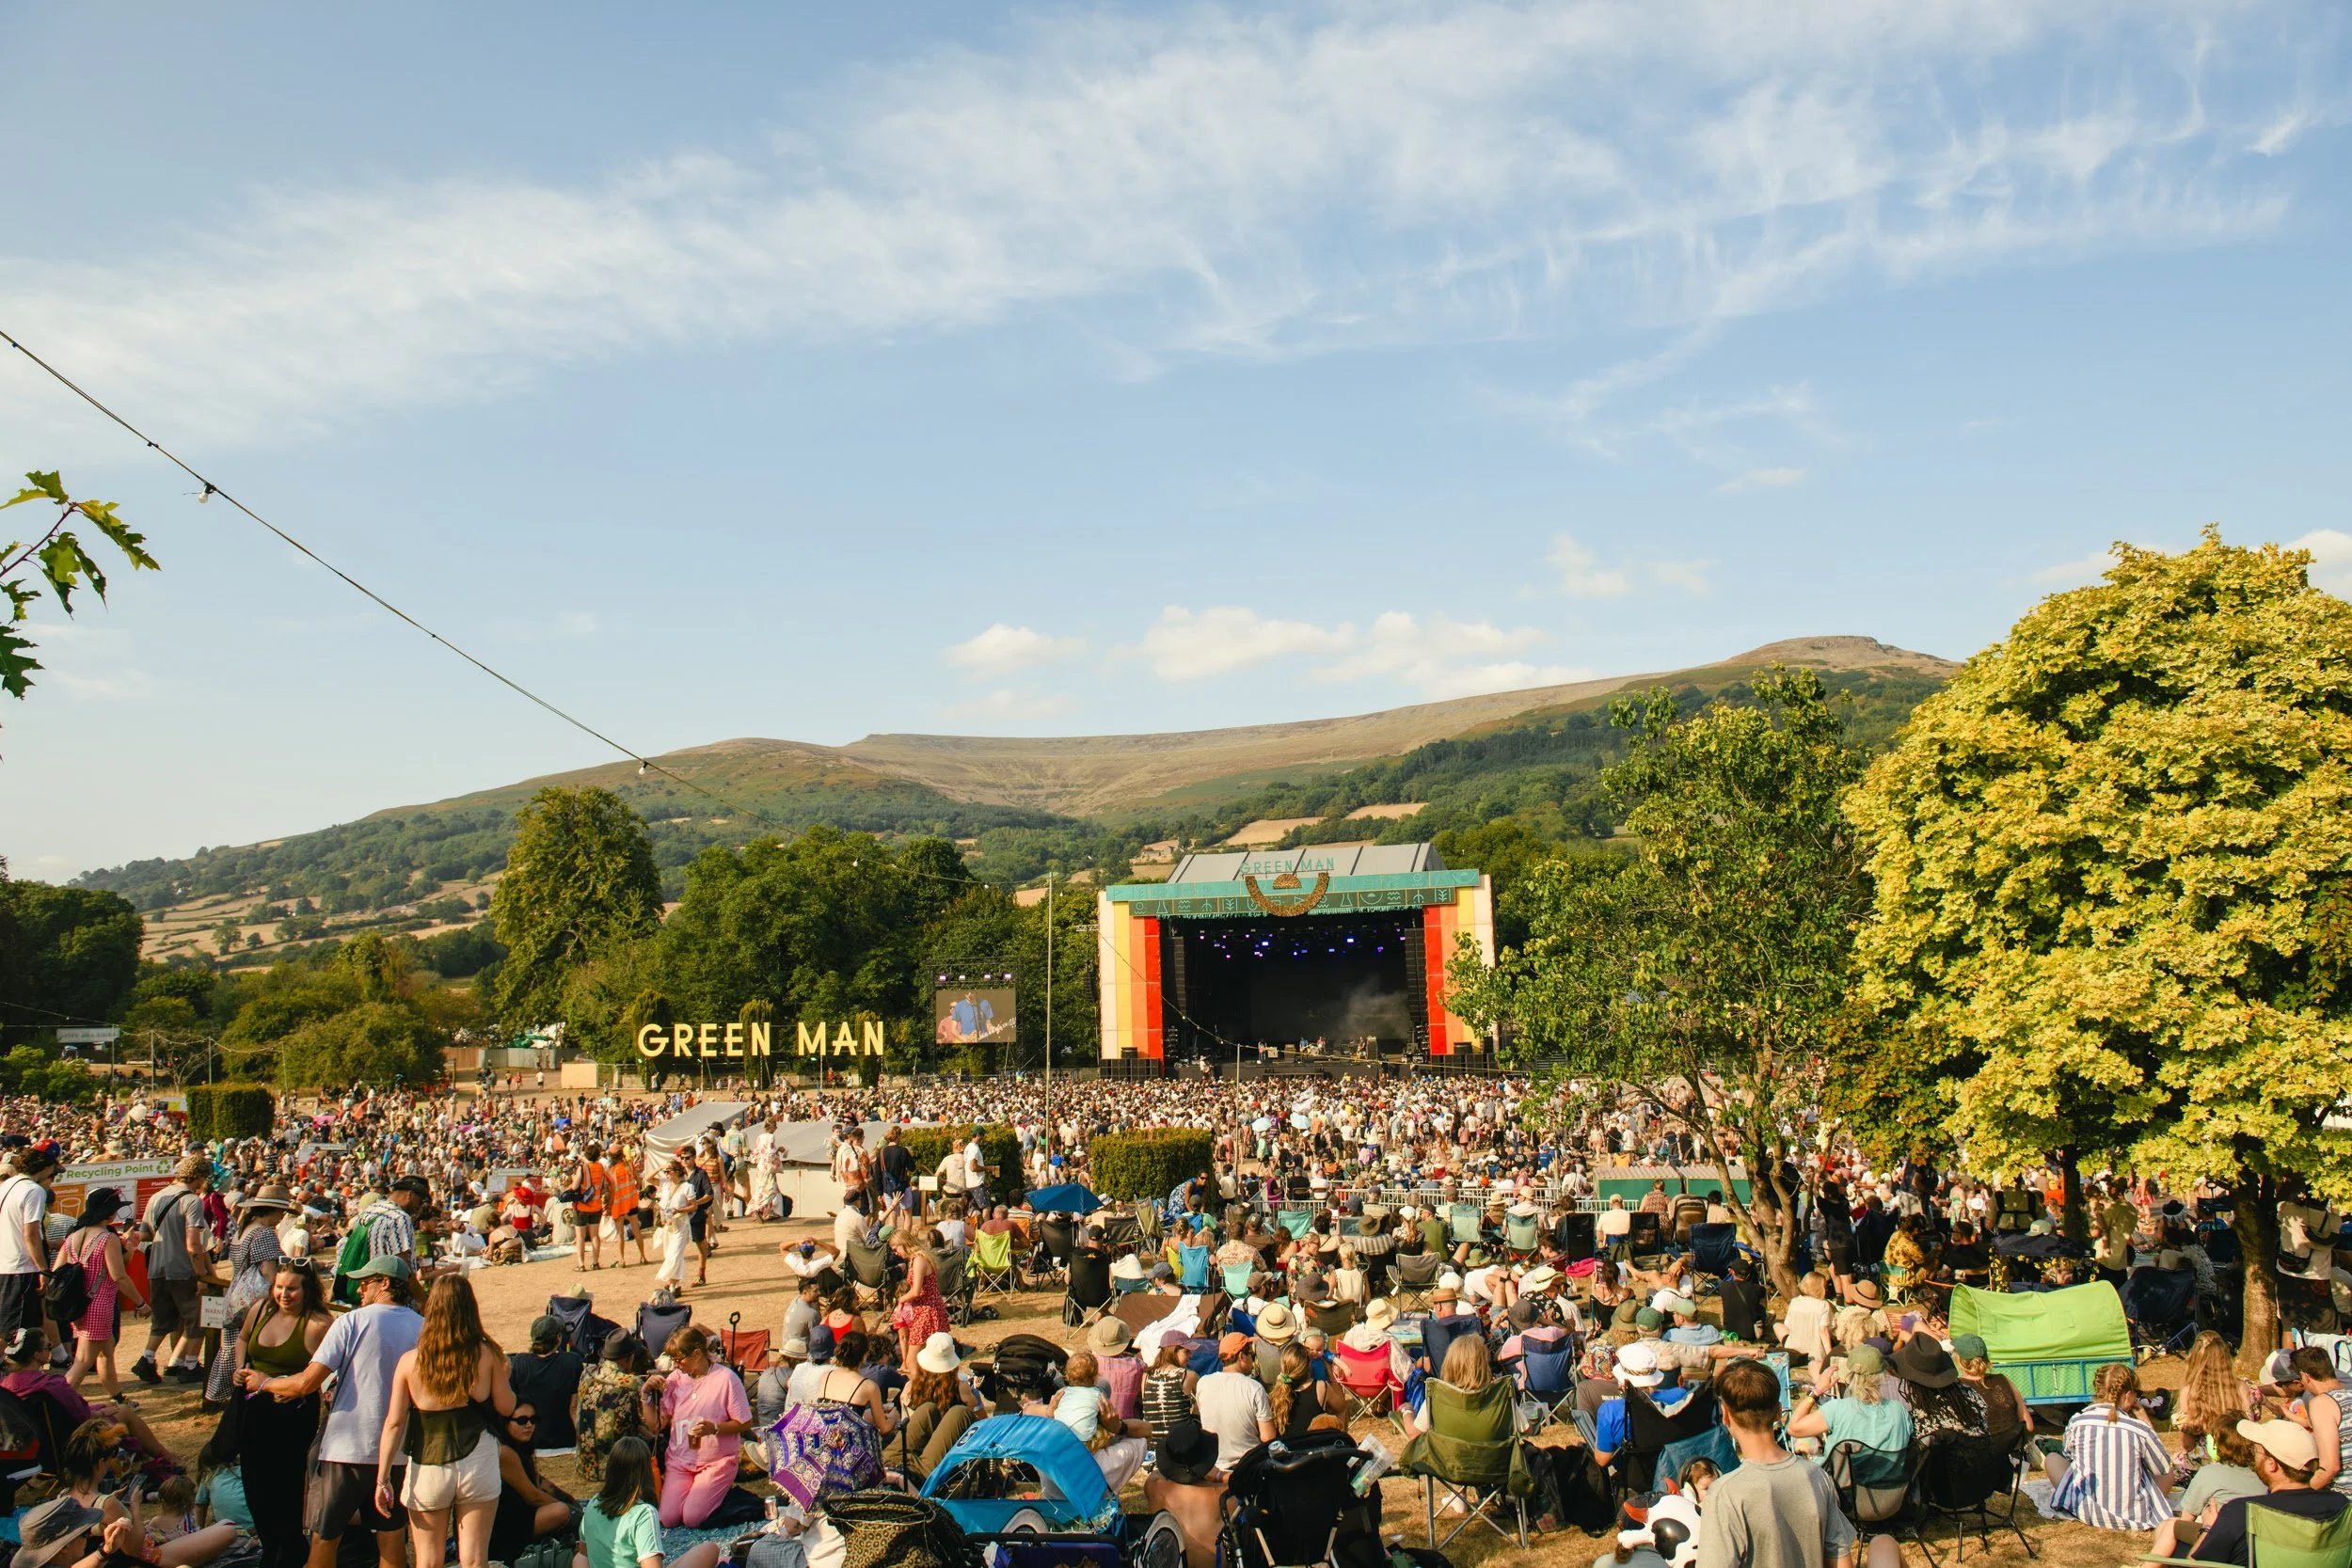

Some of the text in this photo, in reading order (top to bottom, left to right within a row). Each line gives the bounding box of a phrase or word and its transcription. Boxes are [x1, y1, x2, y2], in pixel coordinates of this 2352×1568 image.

[1241, 858, 1334, 873] GREEN MAN
[638, 1022, 883, 1057] GREEN MAN
[67, 1164, 153, 1179] Recycling Point
